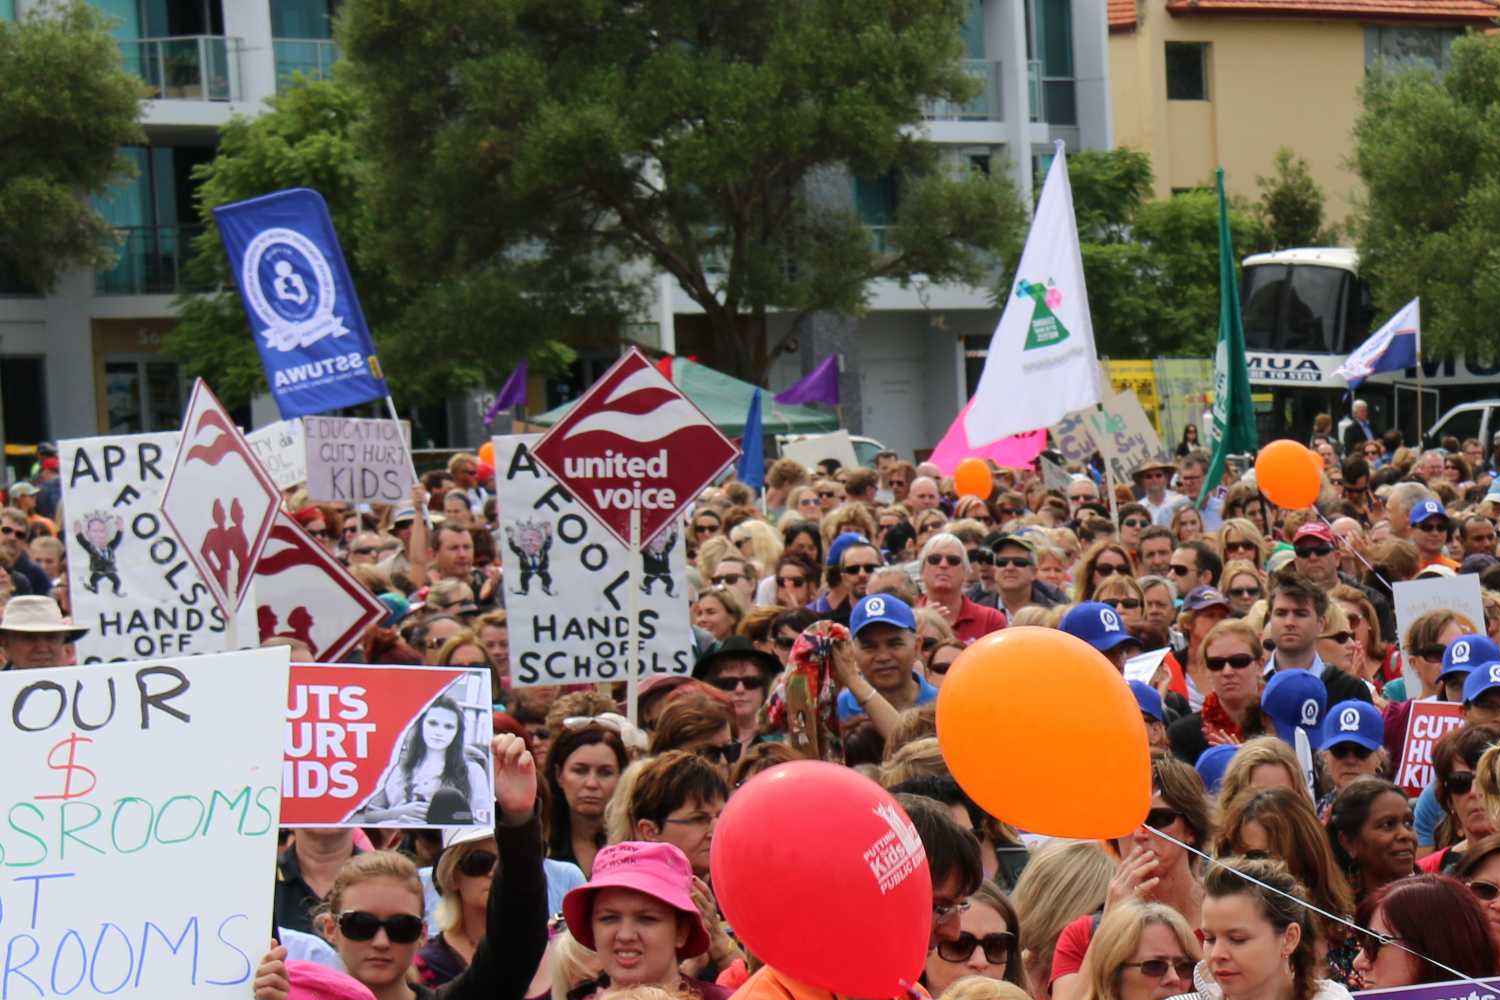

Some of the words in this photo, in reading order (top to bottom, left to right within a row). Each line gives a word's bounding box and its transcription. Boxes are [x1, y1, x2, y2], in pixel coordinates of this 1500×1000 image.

[1246, 358, 1319, 370] MUA
[70, 443, 164, 488] APR
[363, 444, 404, 465] HURT
[564, 450, 668, 478] united
[331, 468, 403, 500] KIDS
[594, 481, 677, 510] voice
[101, 607, 227, 636] HANDS
[534, 609, 660, 643] HANDS
[134, 635, 192, 657] OFF
[12, 665, 191, 731] OUR
[285, 685, 369, 720] UTS
[283, 722, 377, 758] URT
[1413, 715, 1466, 739] CUT
[282, 760, 359, 798] IDS
[0, 786, 278, 867] SROOMS
[870, 842, 907, 879] Kids
[880, 860, 913, 896] PUBLIC
[2, 914, 251, 1000] ROOMS
